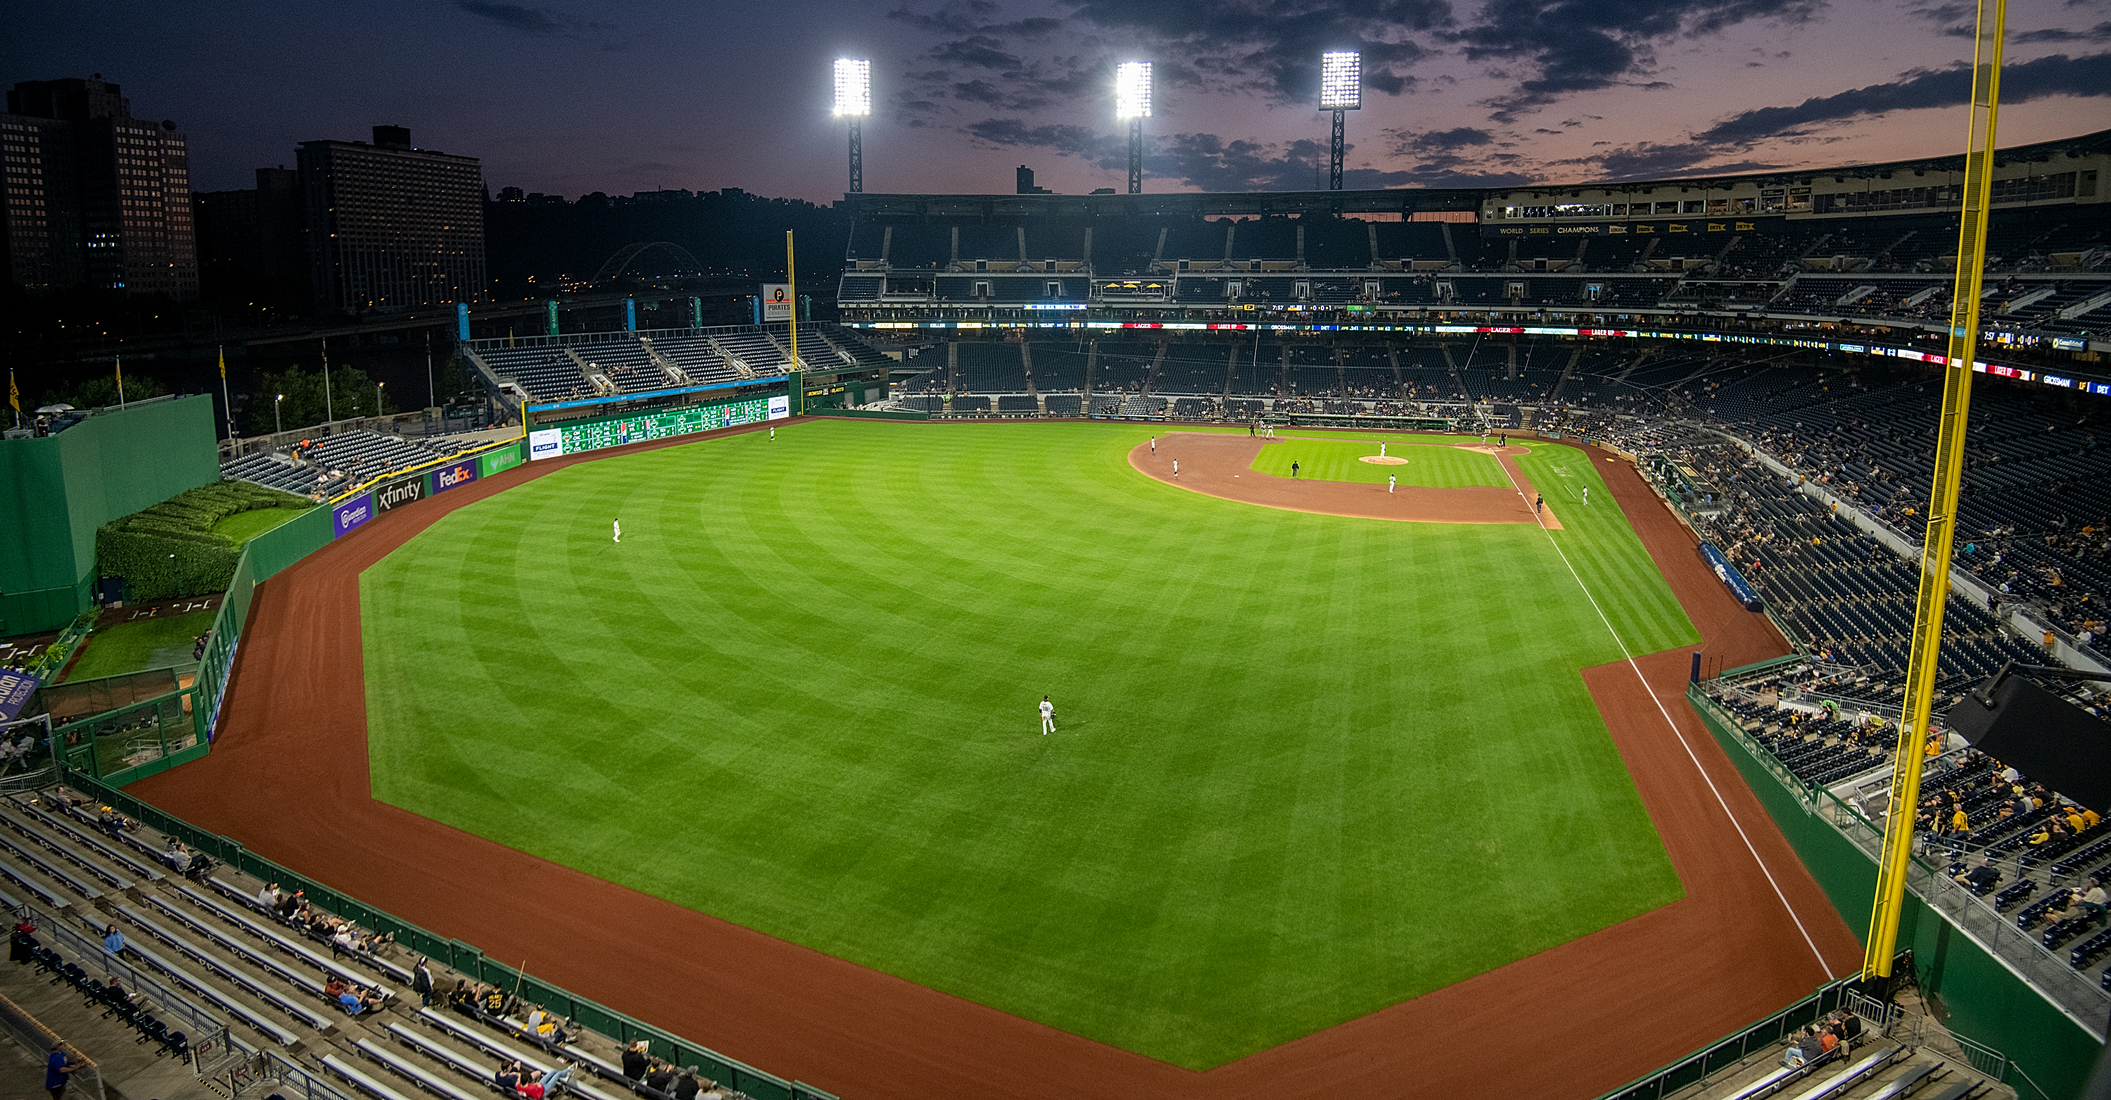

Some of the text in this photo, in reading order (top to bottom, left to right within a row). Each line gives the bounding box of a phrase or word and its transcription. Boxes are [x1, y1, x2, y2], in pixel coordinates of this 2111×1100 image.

[1557, 226, 1599, 234] CHAMPIONS
[2044, 375, 2108, 394] GROSSMAN LF DET
[535, 443, 556, 452] FLIGHT
[500, 451, 515, 465] AHN
[439, 466, 470, 488] FedEx
[379, 479, 421, 510] xfinity
[7, 679, 35, 706] PROTECTION
[488, 999, 502, 1009] 25
